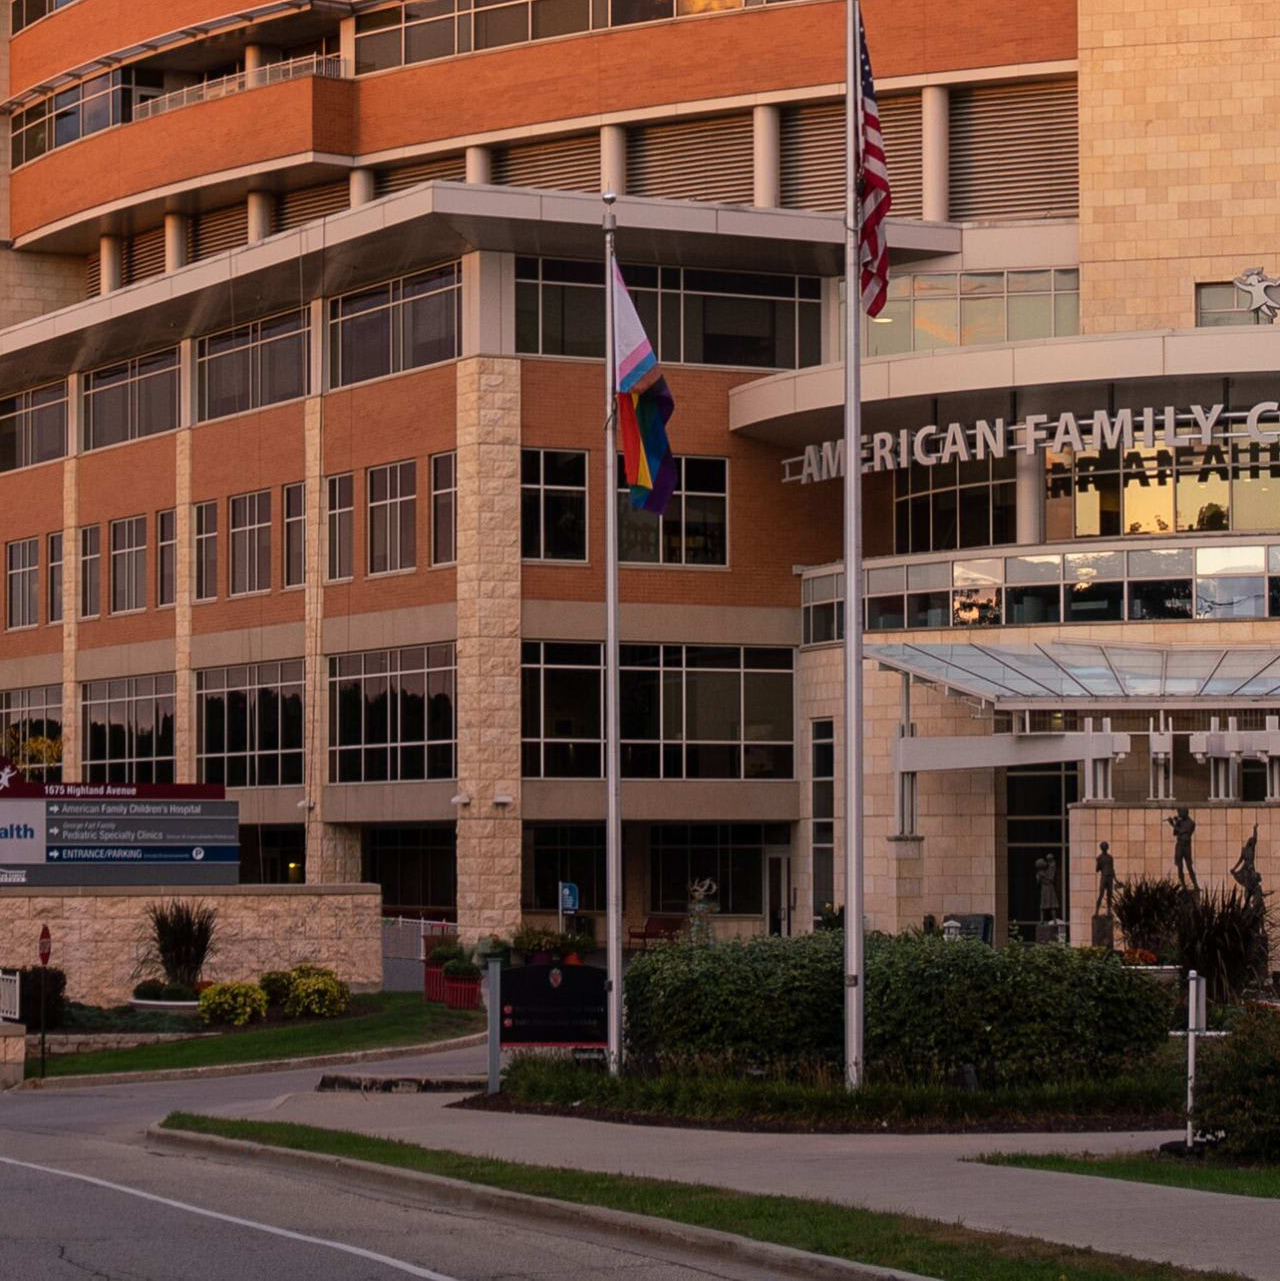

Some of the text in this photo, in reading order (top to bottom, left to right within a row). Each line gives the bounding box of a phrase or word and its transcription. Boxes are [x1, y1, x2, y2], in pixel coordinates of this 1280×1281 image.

[1025, 403, 1225, 456] FAMILY
[44, 785, 137, 797] 1675 Highland Avenue
[62, 803, 202, 816] American Family Children's Hospital
[62, 830, 98, 840] Pediatric
[99, 830, 136, 843] Specialty
[137, 830, 164, 840] Clinics
[62, 848, 143, 859] ENTRANCE/PARKING
